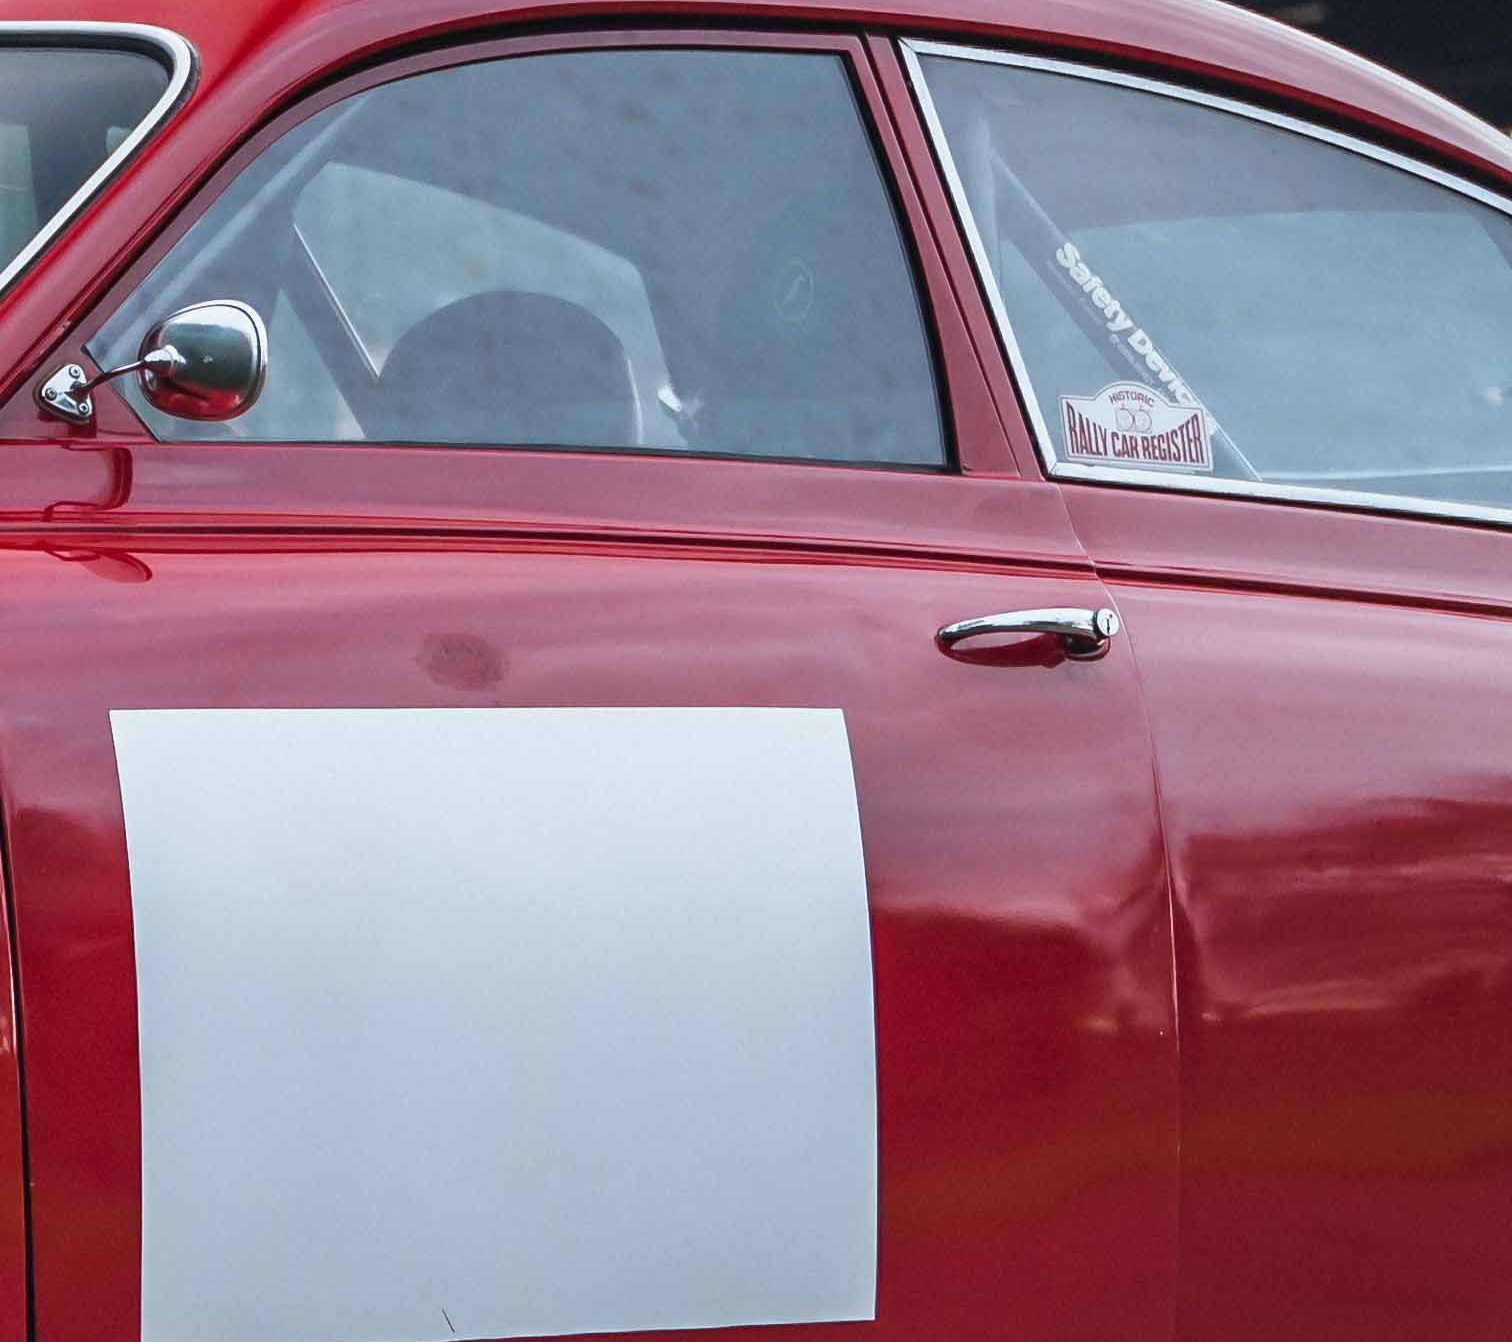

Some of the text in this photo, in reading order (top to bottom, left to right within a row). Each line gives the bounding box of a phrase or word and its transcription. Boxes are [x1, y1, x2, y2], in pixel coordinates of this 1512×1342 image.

[1056, 242, 1133, 331] Safety
[1108, 390, 1155, 407] HISTORIC
[1065, 400, 1205, 464] RALLY CAR REGISTER
